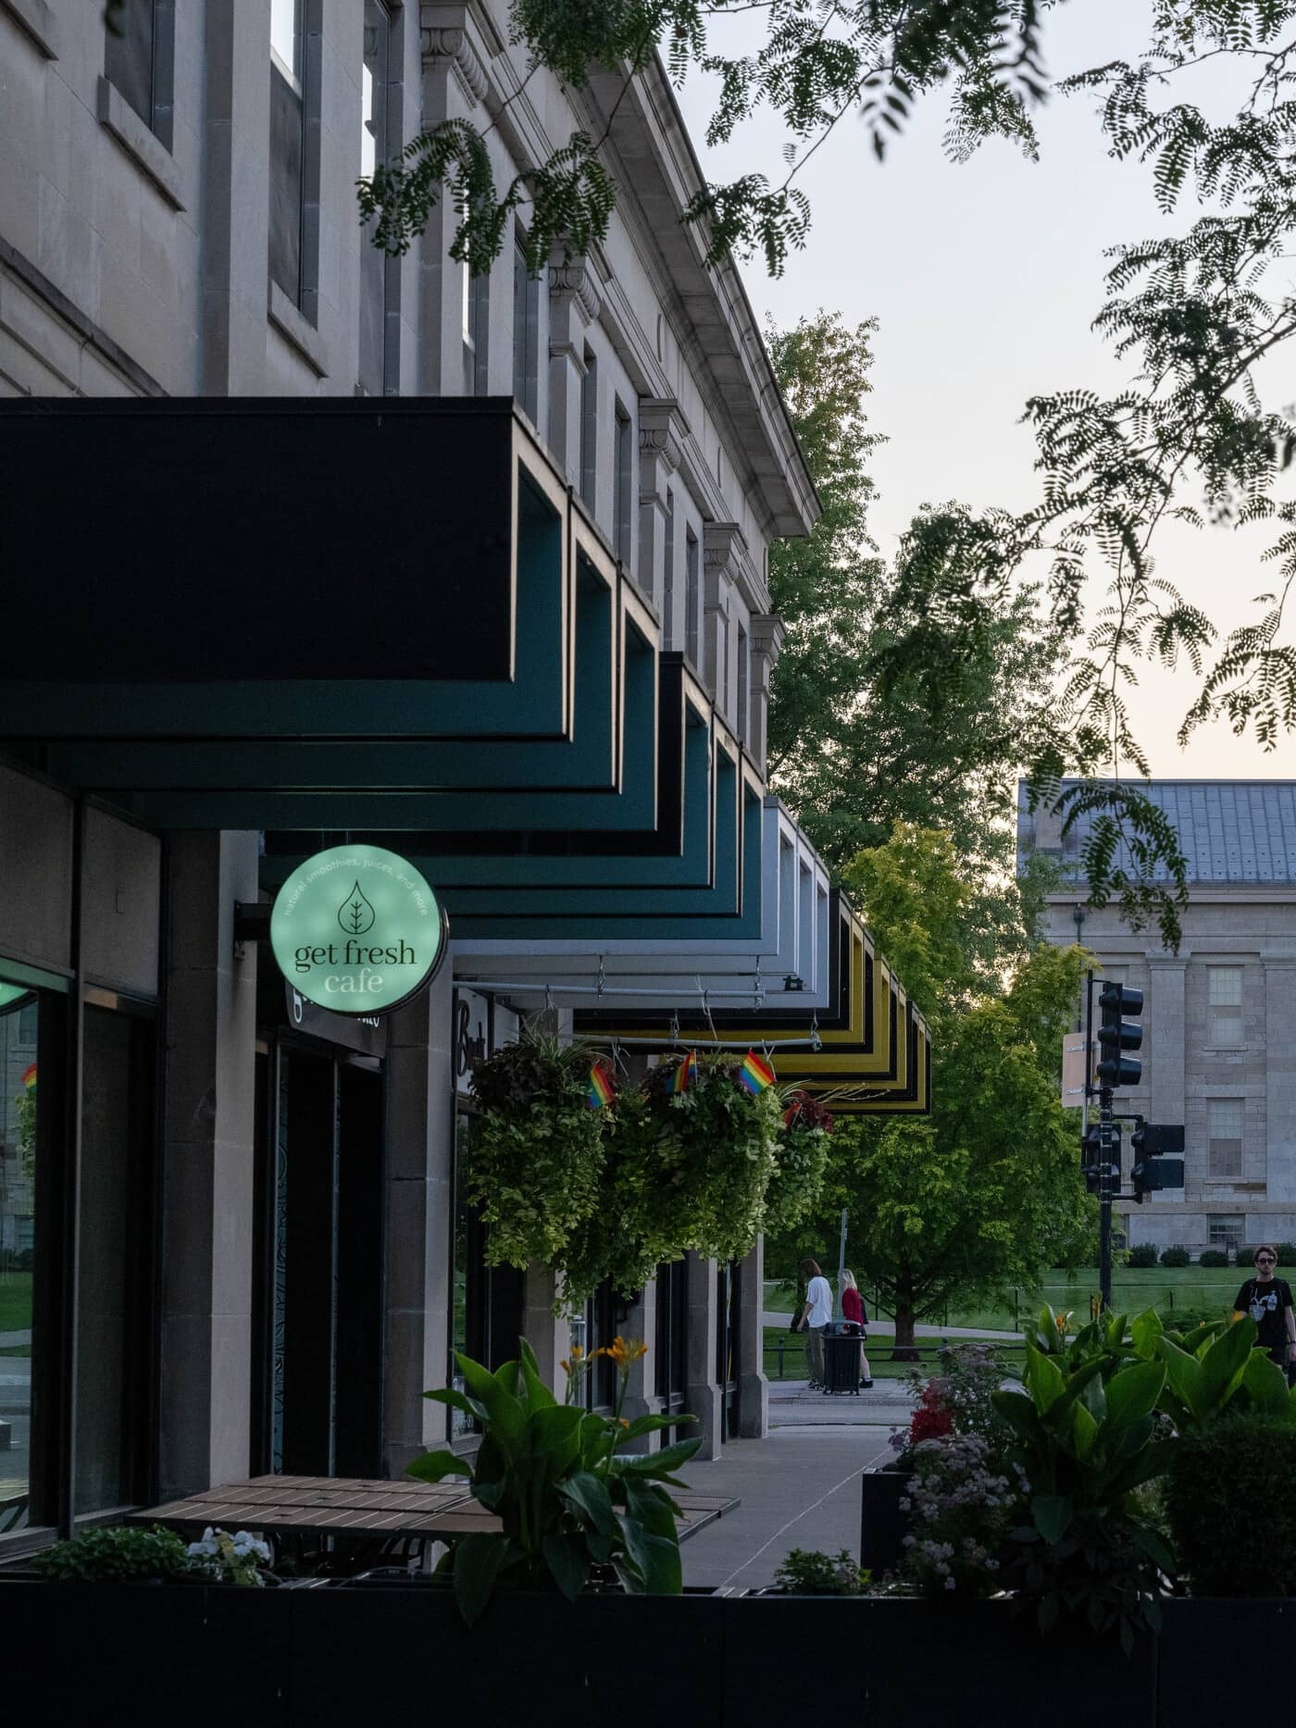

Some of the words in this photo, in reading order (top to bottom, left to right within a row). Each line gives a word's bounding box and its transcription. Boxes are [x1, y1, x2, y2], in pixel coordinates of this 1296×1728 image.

[284, 881, 308, 917] natural
[306, 858, 360, 884] smoothies,
[362, 859, 394, 877] juices,
[396, 873, 416, 890] and
[412, 889, 428, 916] more
[294, 943, 339, 973] get
[344, 939, 417, 965] fresh
[324, 967, 384, 993] cafe
